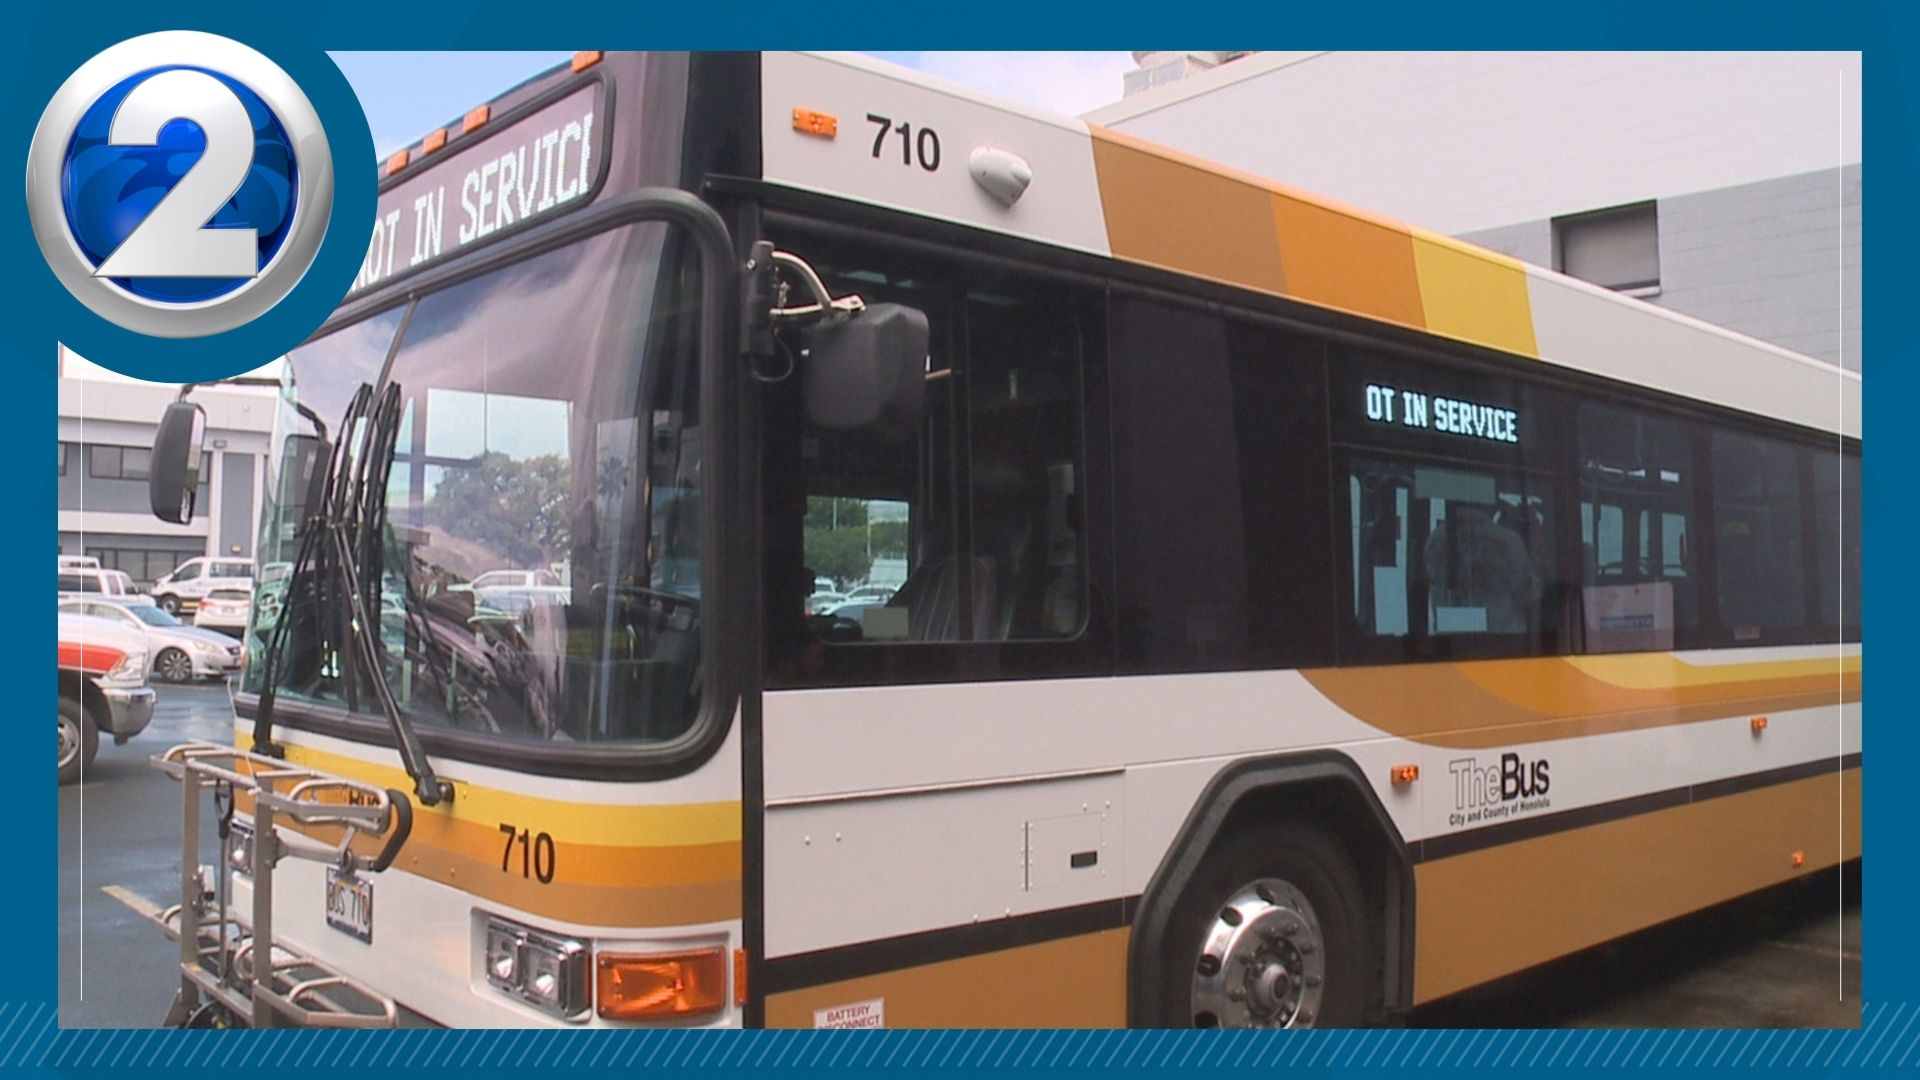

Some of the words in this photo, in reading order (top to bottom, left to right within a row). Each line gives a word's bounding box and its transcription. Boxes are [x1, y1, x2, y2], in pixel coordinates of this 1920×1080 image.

[866, 113, 940, 172] 710
[410, 186, 445, 266] IN
[1366, 384, 1395, 422] OT
[1402, 391, 1427, 428] IN
[1434, 397, 1518, 442] SERVICE
[1449, 752, 1550, 811] TheBus
[1449, 812, 1465, 826] City
[1467, 809, 1481, 822] and
[1483, 805, 1509, 818] County
[1511, 801, 1518, 814] of
[1520, 797, 1550, 811] Honolulu
[500, 823, 555, 884] 710
[351, 888, 370, 926] 710
[818, 1014, 880, 1029] CONNECT
[827, 1006, 870, 1022] BATTERY
